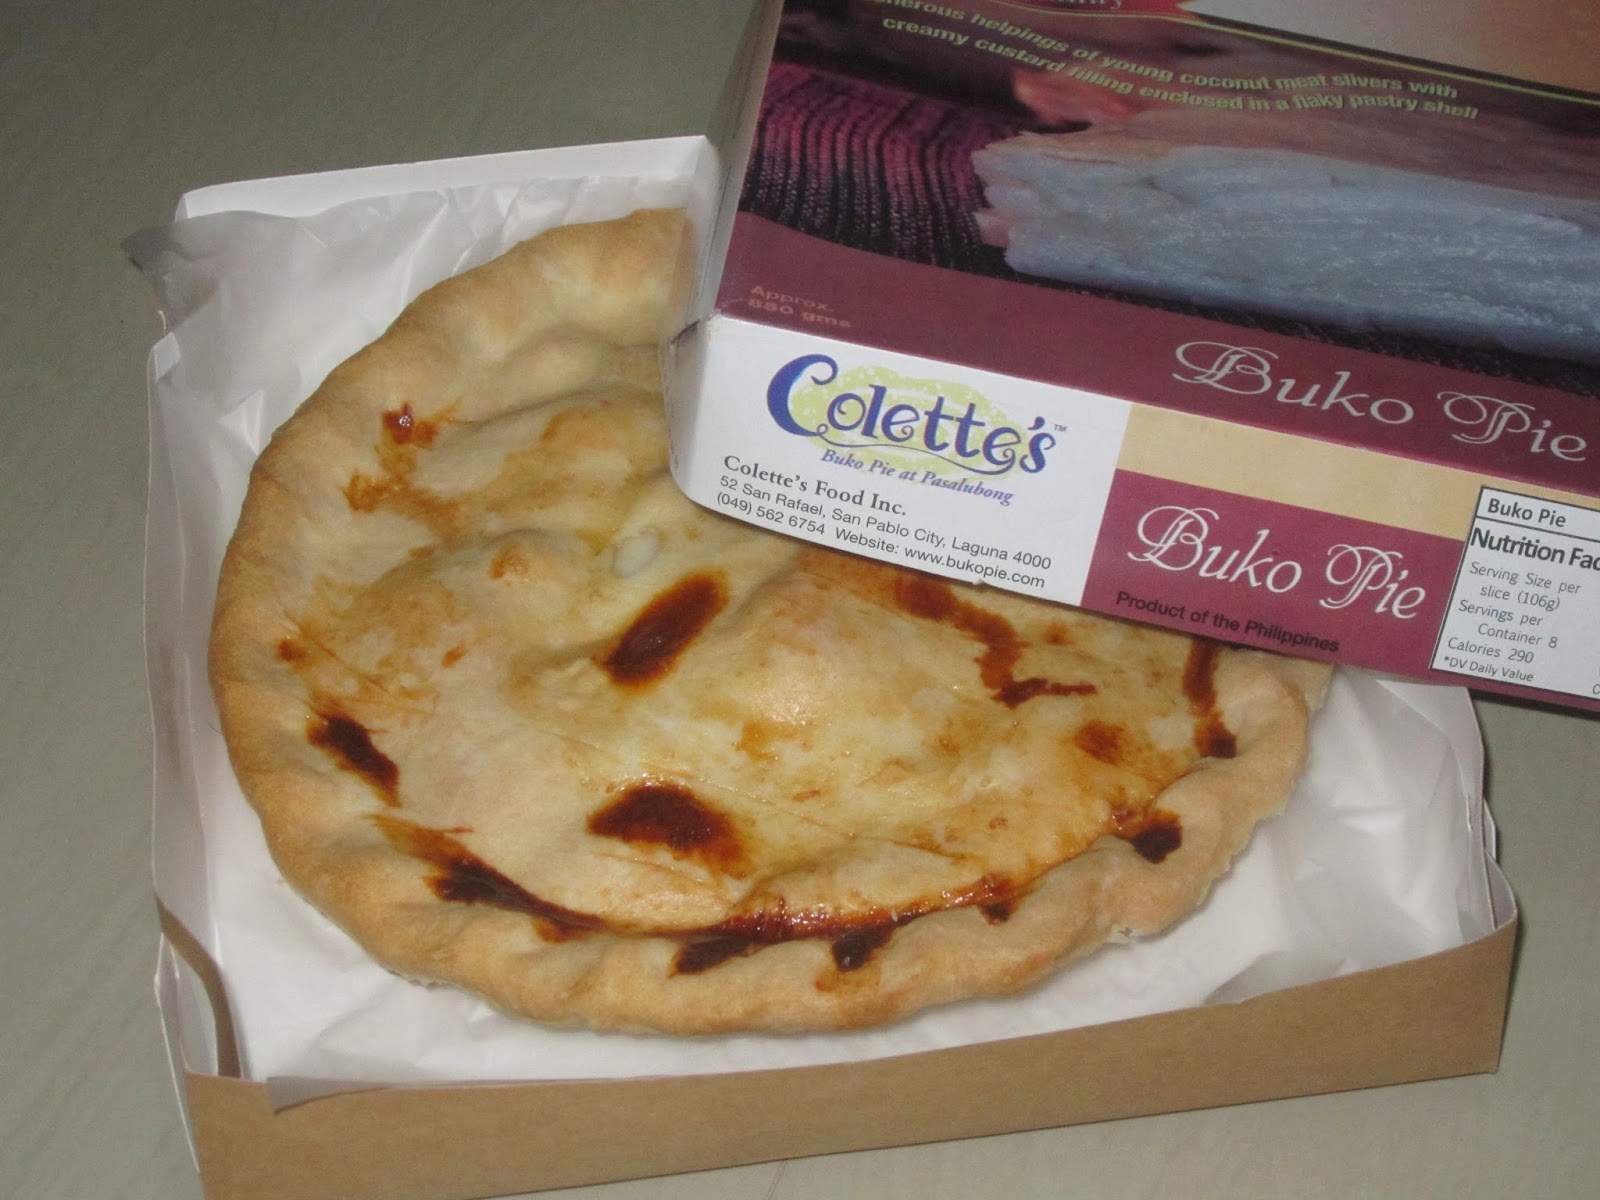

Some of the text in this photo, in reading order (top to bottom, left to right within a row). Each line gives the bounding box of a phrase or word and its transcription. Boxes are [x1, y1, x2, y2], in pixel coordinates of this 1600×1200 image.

[882, 18, 970, 45] creamy
[974, 39, 1066, 72] custard
[1067, 66, 1136, 94] filling
[1139, 86, 1245, 110] enclosed
[1249, 97, 1271, 111] in
[1275, 98, 1291, 111] a
[1348, 94, 1419, 112] pastry
[1422, 99, 1480, 120] shell
[970, 13, 1070, 52] helpings
[1073, 48, 1099, 60] of
[1100, 56, 1174, 82] young
[1180, 71, 1272, 90] coconut
[1274, 74, 1328, 91] meat
[1331, 73, 1403, 91] slivers
[1407, 82, 1459, 99] with
[751, 285, 835, 313] Approx.
[766, 353, 1058, 475] Colette's
[1171, 341, 1588, 462] Buko Pie
[723, 455, 908, 517] Colette's Food Inc.
[820, 448, 1015, 507] Buko Pie at Pasalubong
[716, 491, 1047, 589] (049) 562 6754 Website: www.bukopie.com
[719, 475, 1053, 571] 52 San Rafael, San Pablo City, Laguna 4000
[1487, 497, 1567, 528] Buko Pie
[1127, 505, 1426, 619] Buko Pie
[1470, 526, 1566, 564] Nutrition
[1469, 560, 1582, 595] Serving Size per
[1479, 584, 1561, 613] slice (106g)
[1115, 590, 1340, 652] Product of the Philippines
[1458, 599, 1544, 627] Servings per
[1478, 622, 1559, 649] Container 8
[1447, 636, 1535, 664] Calories 290
[1469, 660, 1499, 677] Daily
[1501, 669, 1535, 683] Value
